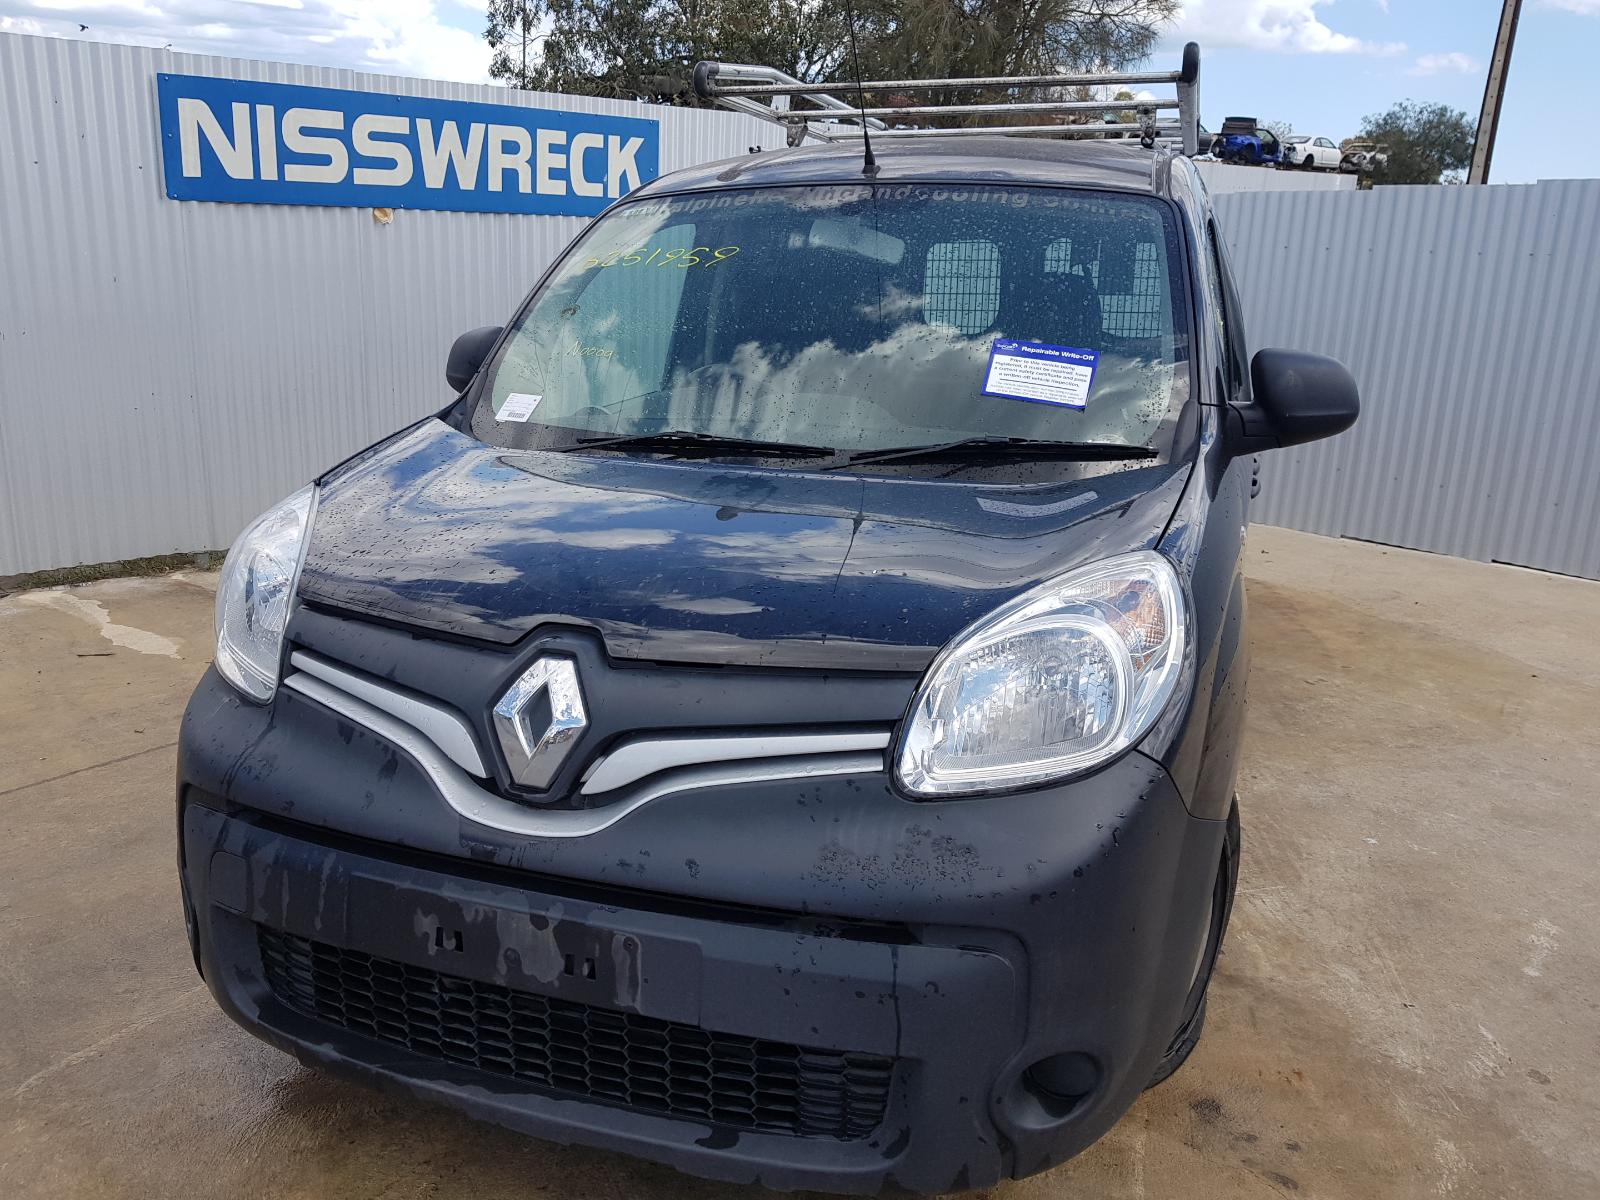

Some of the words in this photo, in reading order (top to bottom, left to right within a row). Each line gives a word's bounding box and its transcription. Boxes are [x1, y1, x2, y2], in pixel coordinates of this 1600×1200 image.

[177, 97, 645, 199] NISSWRECK
[1021, 346, 1060, 356] Repairable
[1061, 352, 1094, 360] Write-Off
